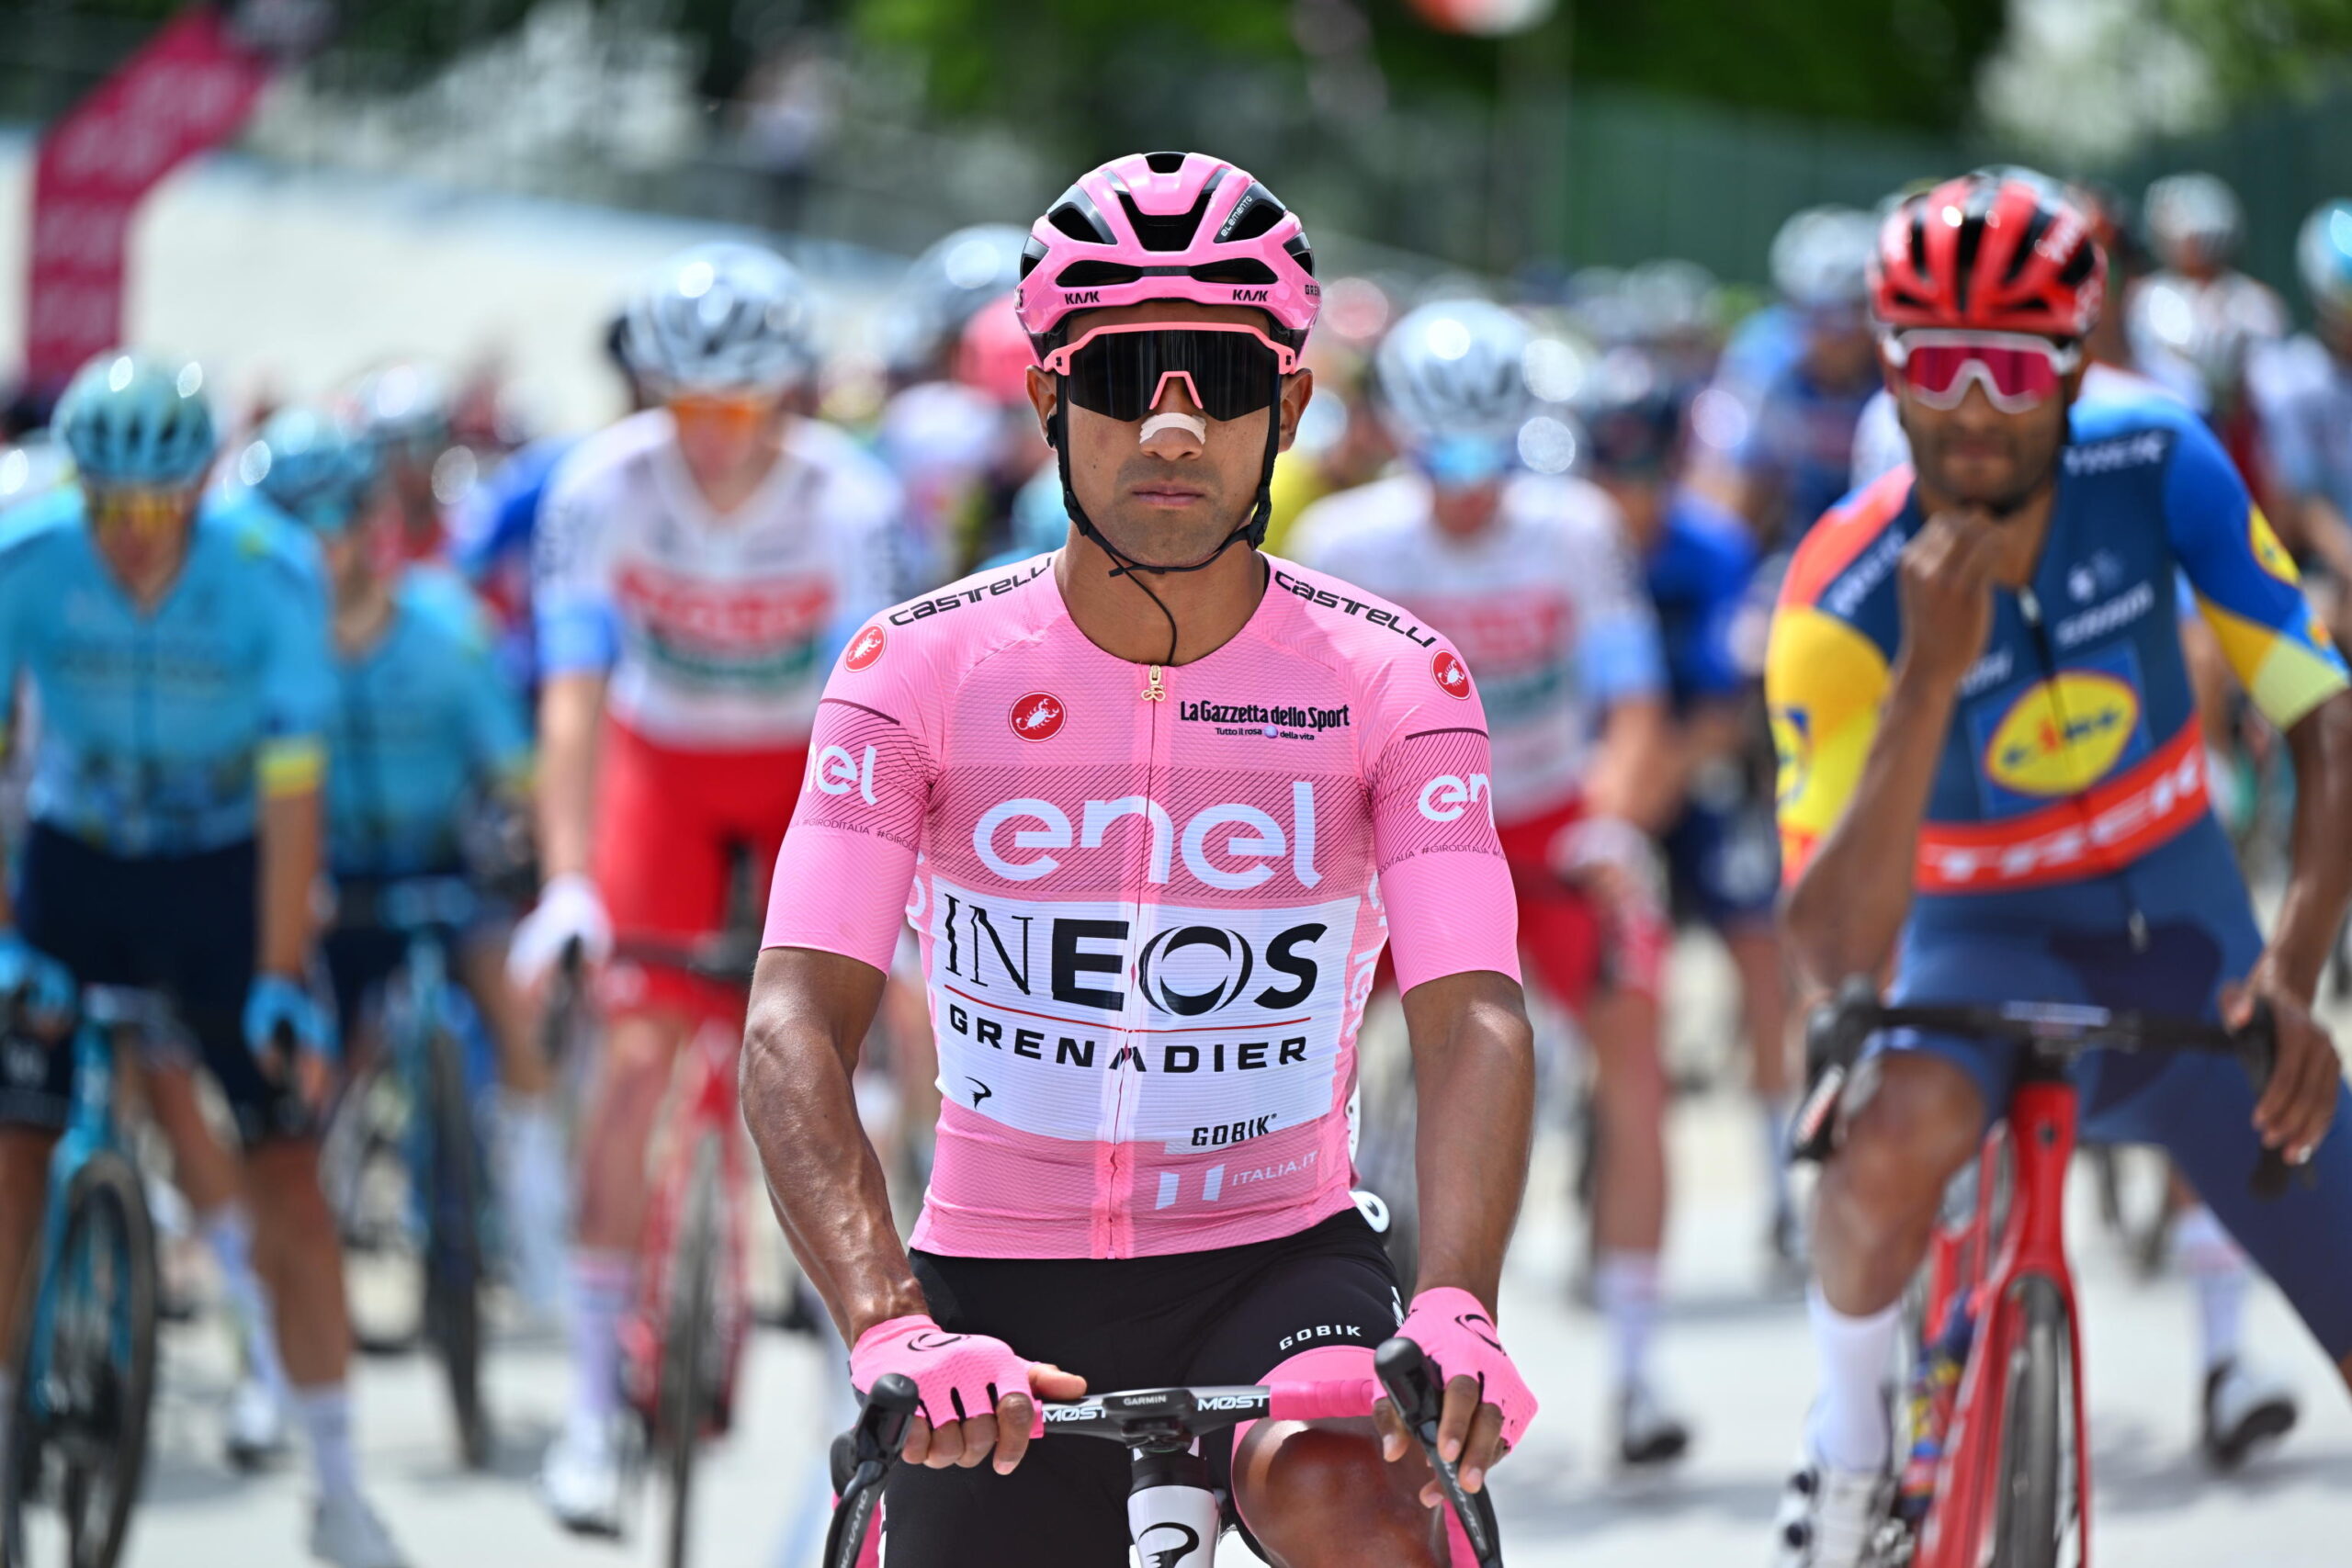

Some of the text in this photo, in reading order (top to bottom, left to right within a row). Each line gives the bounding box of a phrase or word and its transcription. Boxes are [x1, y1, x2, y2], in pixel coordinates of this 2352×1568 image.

[1181, 700, 1350, 732] La Gazzetta dello Sport
[1215, 728, 1238, 736] Tutto
[1280, 731, 1298, 739] della
[1299, 732, 1315, 741] vita
[1418, 773, 1495, 829] en
[973, 781, 1323, 890] enel
[1421, 844, 1489, 855] #GIRODITALIA
[944, 893, 1328, 1016] INEOS
[950, 1003, 1308, 1073] GRENADIER
[1232, 1150, 1318, 1187] ITALIA.IT
[1279, 1325, 1362, 1350] GOBIK
[1123, 1394, 1168, 1406] GARMIN
